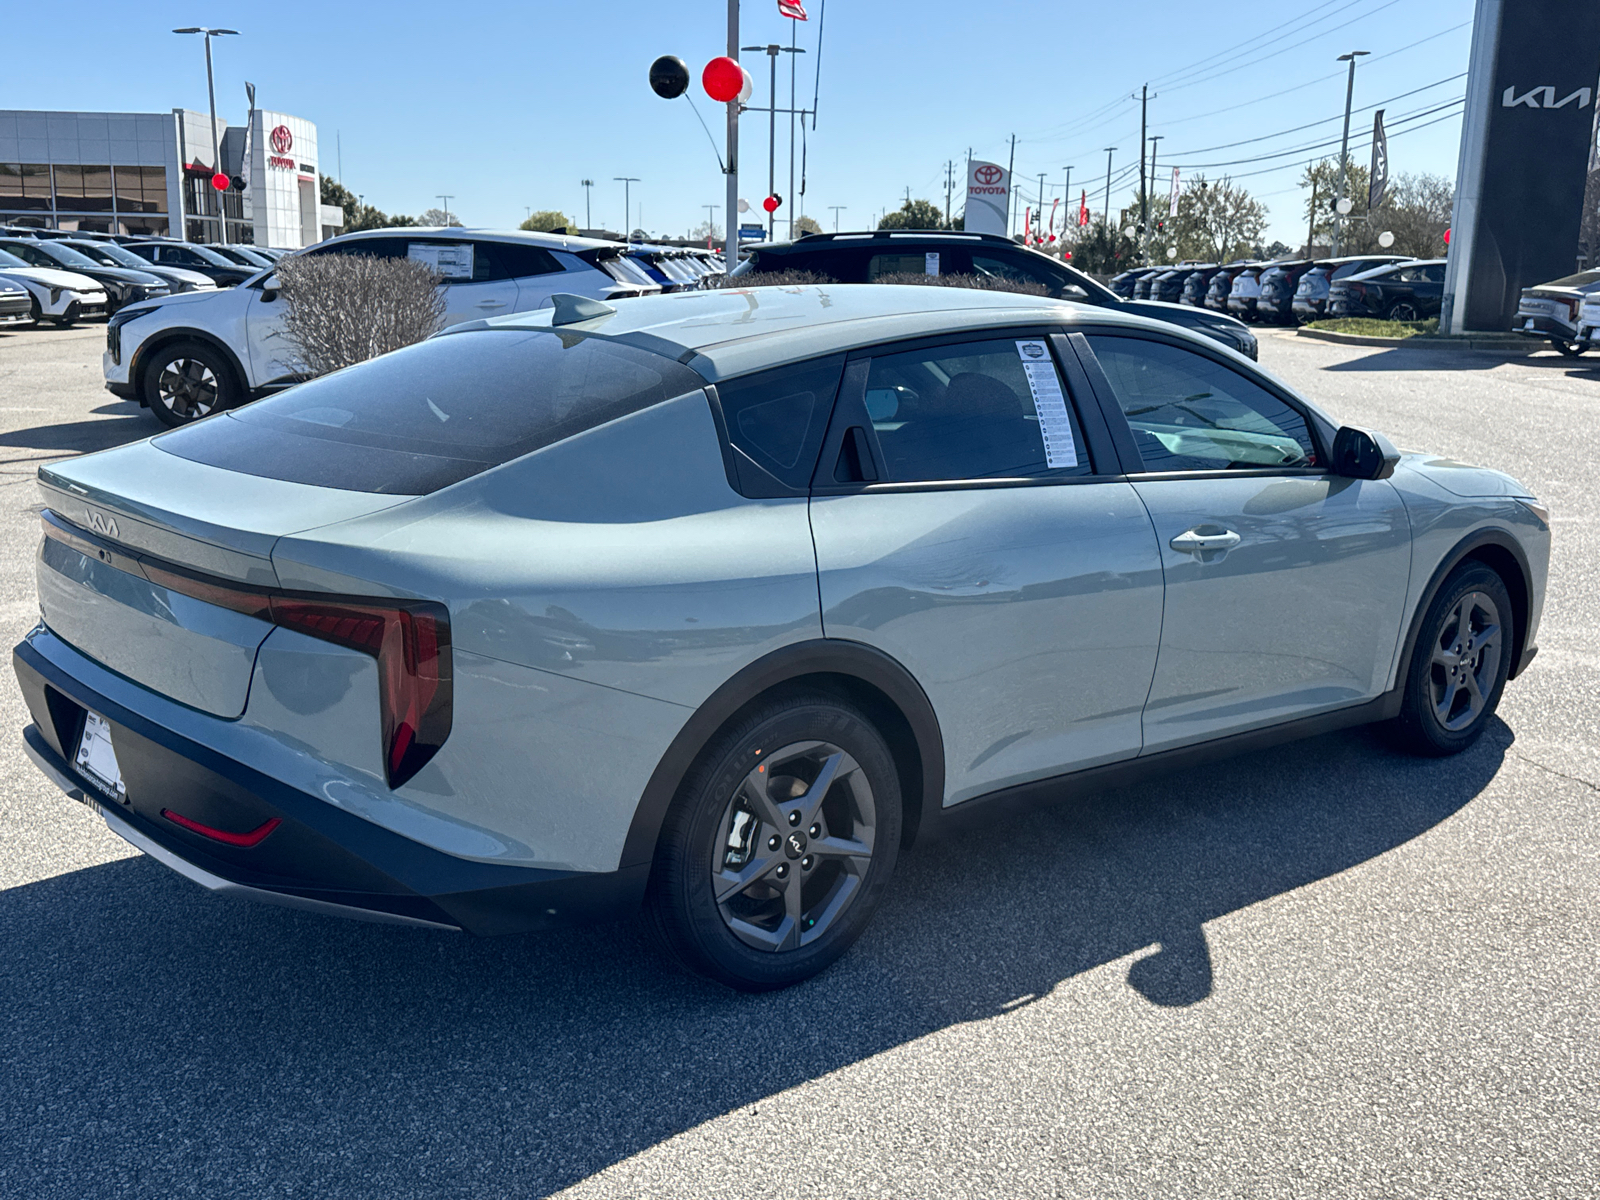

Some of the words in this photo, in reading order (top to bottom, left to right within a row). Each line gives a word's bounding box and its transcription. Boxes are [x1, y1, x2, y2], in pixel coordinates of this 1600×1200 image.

[1502, 85, 1591, 109] KIA
[270, 156, 296, 169] TOYOTA
[968, 186, 1007, 195] TOYOTA
[85, 508, 120, 539] KIA
[707, 741, 762, 816] SOLUS
